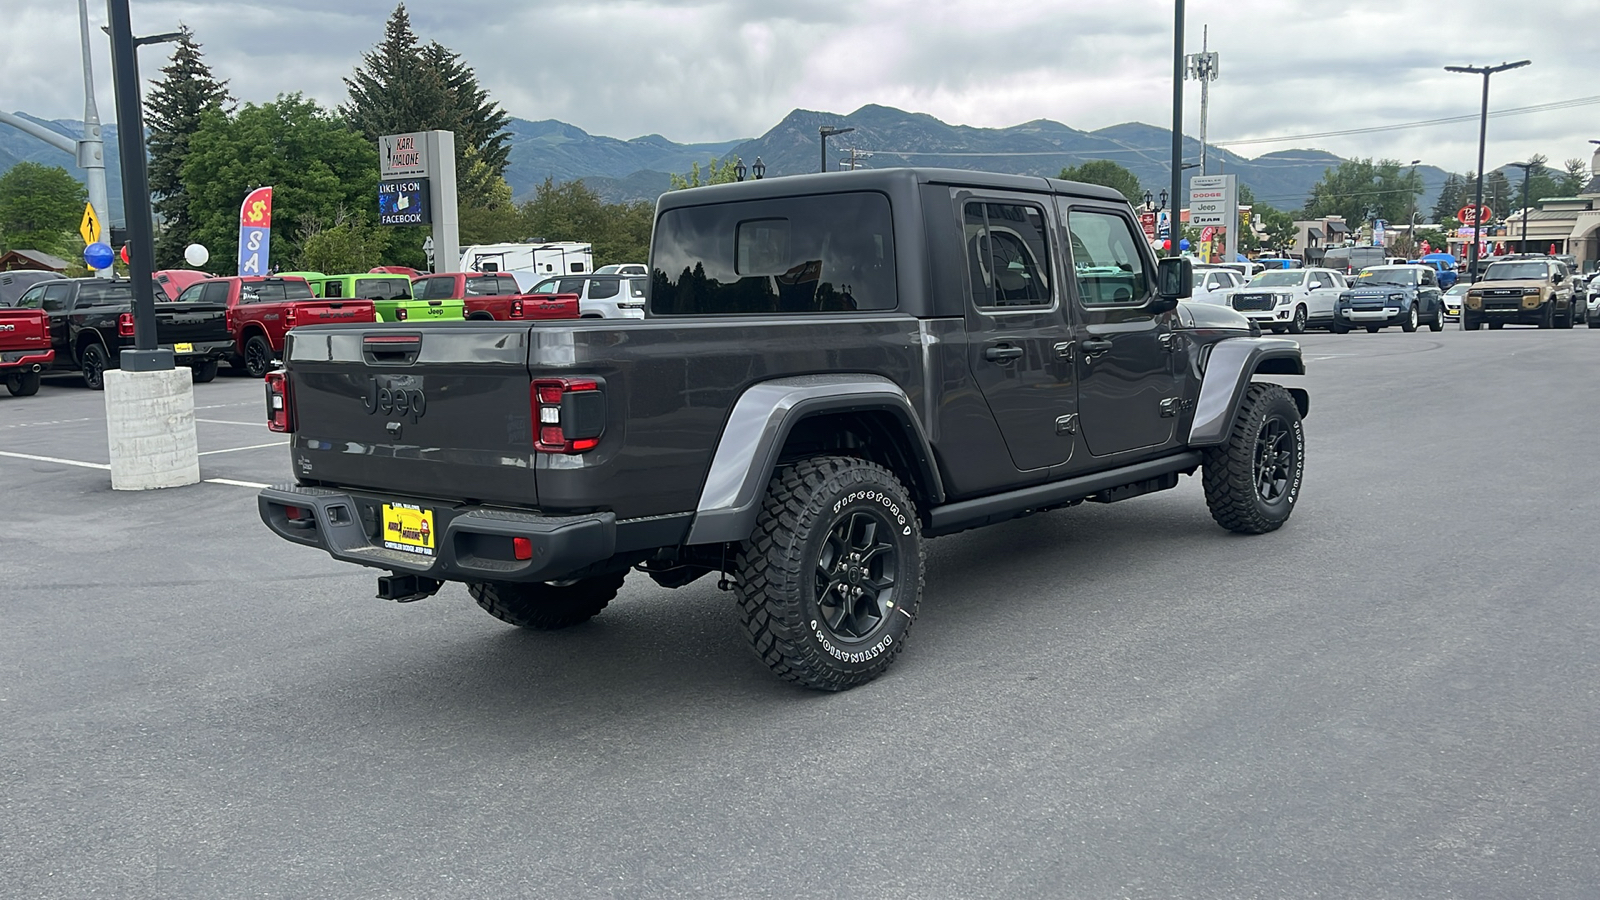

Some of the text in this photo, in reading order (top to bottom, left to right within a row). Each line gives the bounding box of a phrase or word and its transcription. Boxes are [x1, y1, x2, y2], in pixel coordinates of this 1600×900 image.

[397, 137, 414, 151] KARL
[392, 153, 420, 168] MALONE
[379, 182, 420, 194] LIKE US ON
[382, 214, 421, 224] FACEBOOK
[428, 308, 444, 316] Jeep
[361, 377, 426, 424] Jeep
[833, 490, 906, 525] Firestone
[816, 634, 893, 664] DESTINATION
